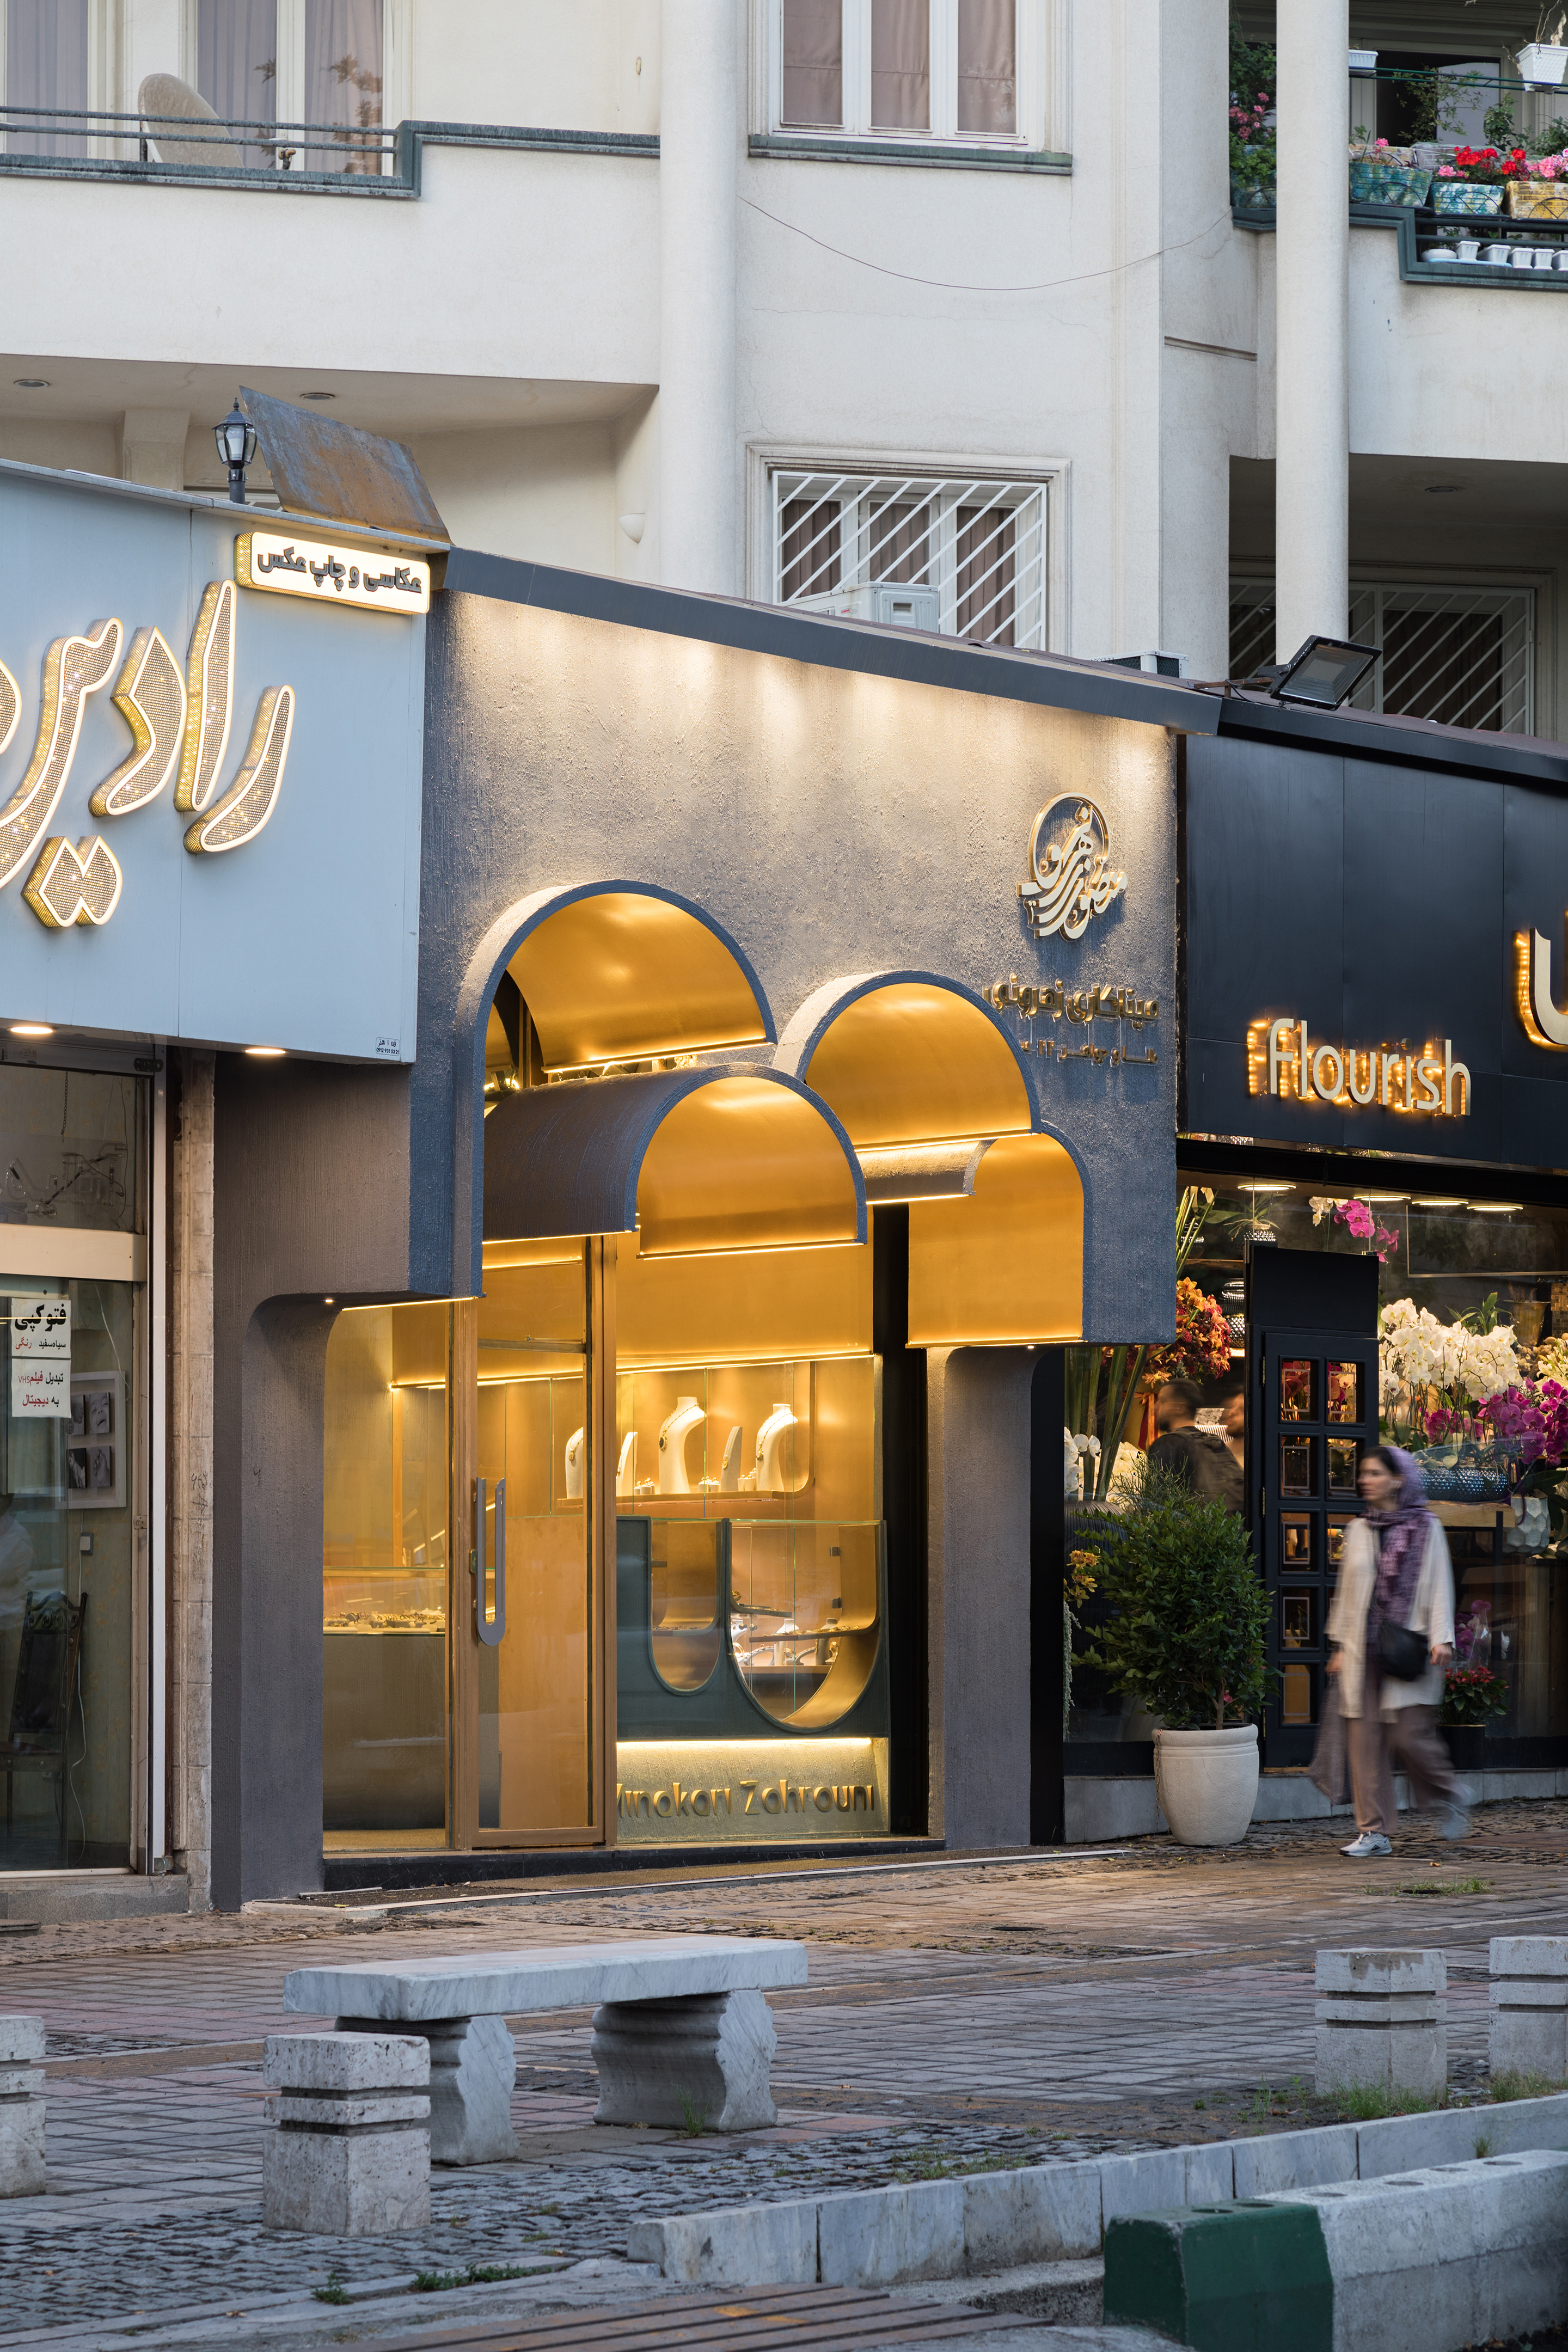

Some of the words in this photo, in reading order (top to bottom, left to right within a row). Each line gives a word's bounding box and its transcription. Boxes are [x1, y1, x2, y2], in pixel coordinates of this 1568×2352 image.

[258, 546, 307, 573] عکس
[309, 555, 346, 591] چاپ
[348, 566, 360, 589] و
[363, 567, 422, 594] عکاسی
[1068, 986, 1160, 1028] میناکاری
[1266, 1018, 1471, 1116] flourish
[15, 1337, 32, 1350] رنگی
[45, 1372, 64, 1385] تبدیل
[22, 1394, 48, 1407] دیجیتال
[51, 1396, 59, 1407] به
[740, 1779, 874, 1815] Zahrouni
